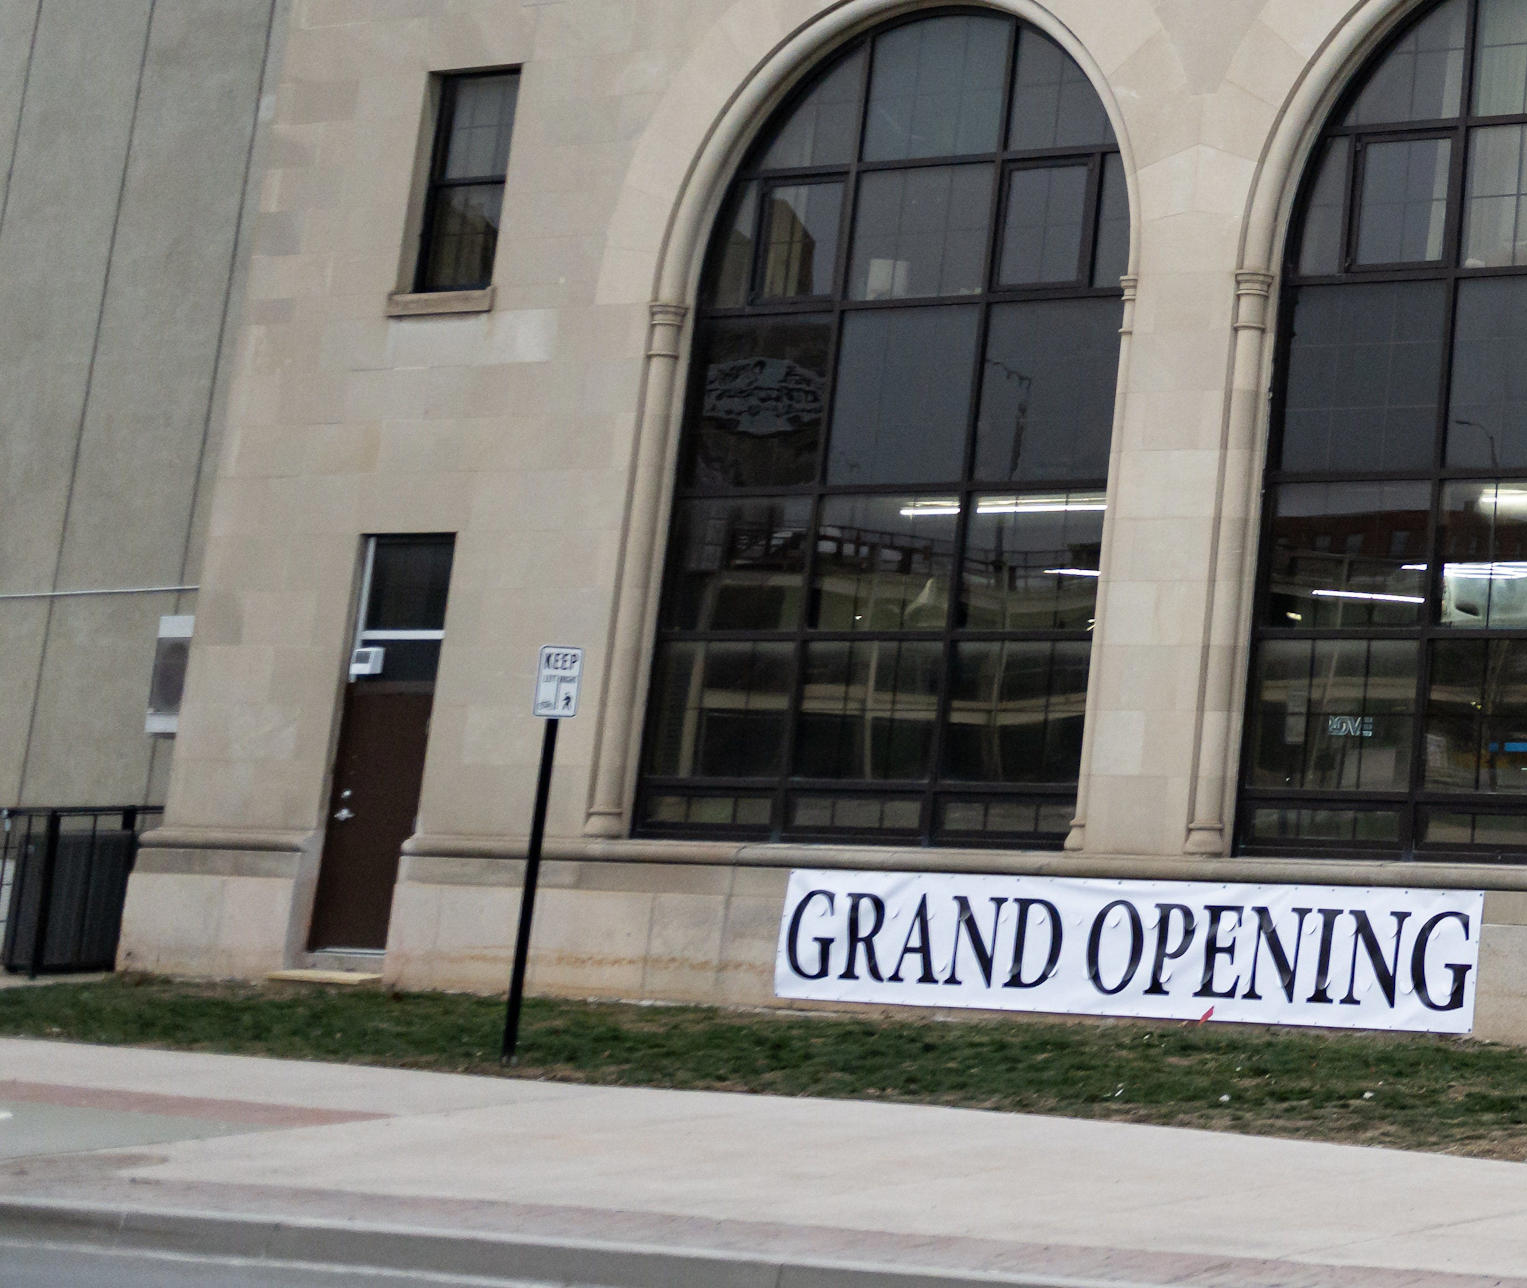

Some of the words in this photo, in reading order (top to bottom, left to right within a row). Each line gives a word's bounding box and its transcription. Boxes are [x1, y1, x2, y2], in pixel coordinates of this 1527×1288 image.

[544, 652, 578, 671] KEEP
[786, 888, 1063, 990] GRAND
[1086, 899, 1474, 1013] OPENING
